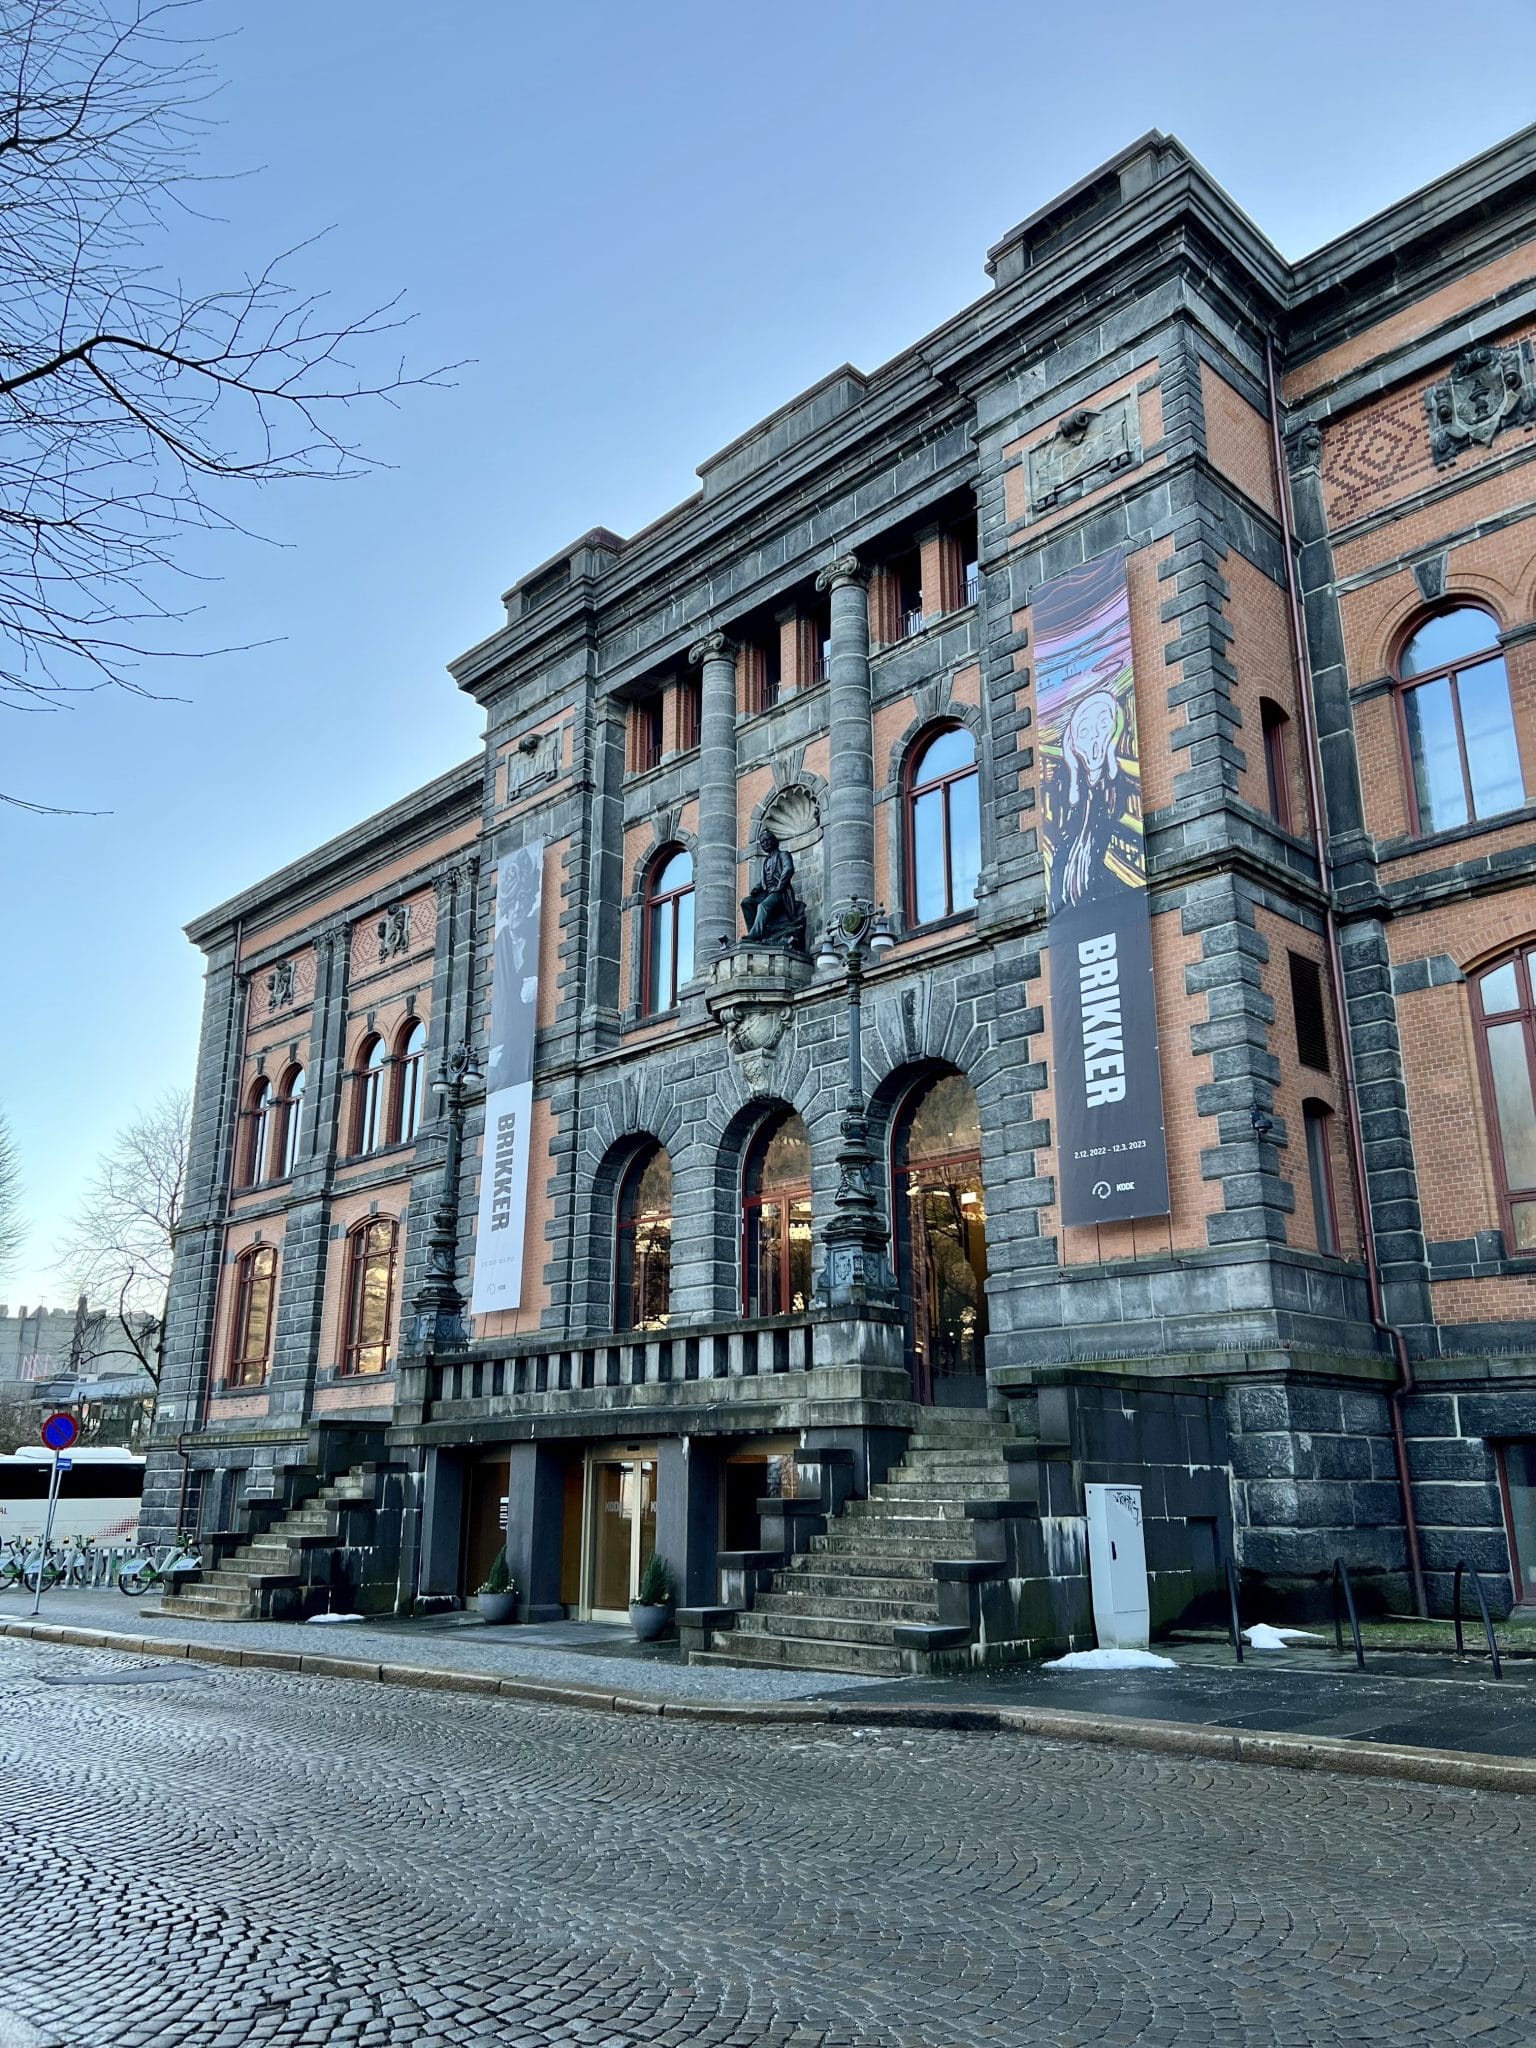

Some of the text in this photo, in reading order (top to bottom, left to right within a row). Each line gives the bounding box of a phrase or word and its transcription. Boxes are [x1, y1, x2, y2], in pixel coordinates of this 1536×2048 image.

[1078, 932, 1126, 1109] BRIKKER
[491, 1113, 516, 1233] BRIKKER
[1090, 1147, 1106, 1156] 2022
[1128, 1140, 1147, 1150] 2023
[1116, 1181, 1135, 1191] KODE
